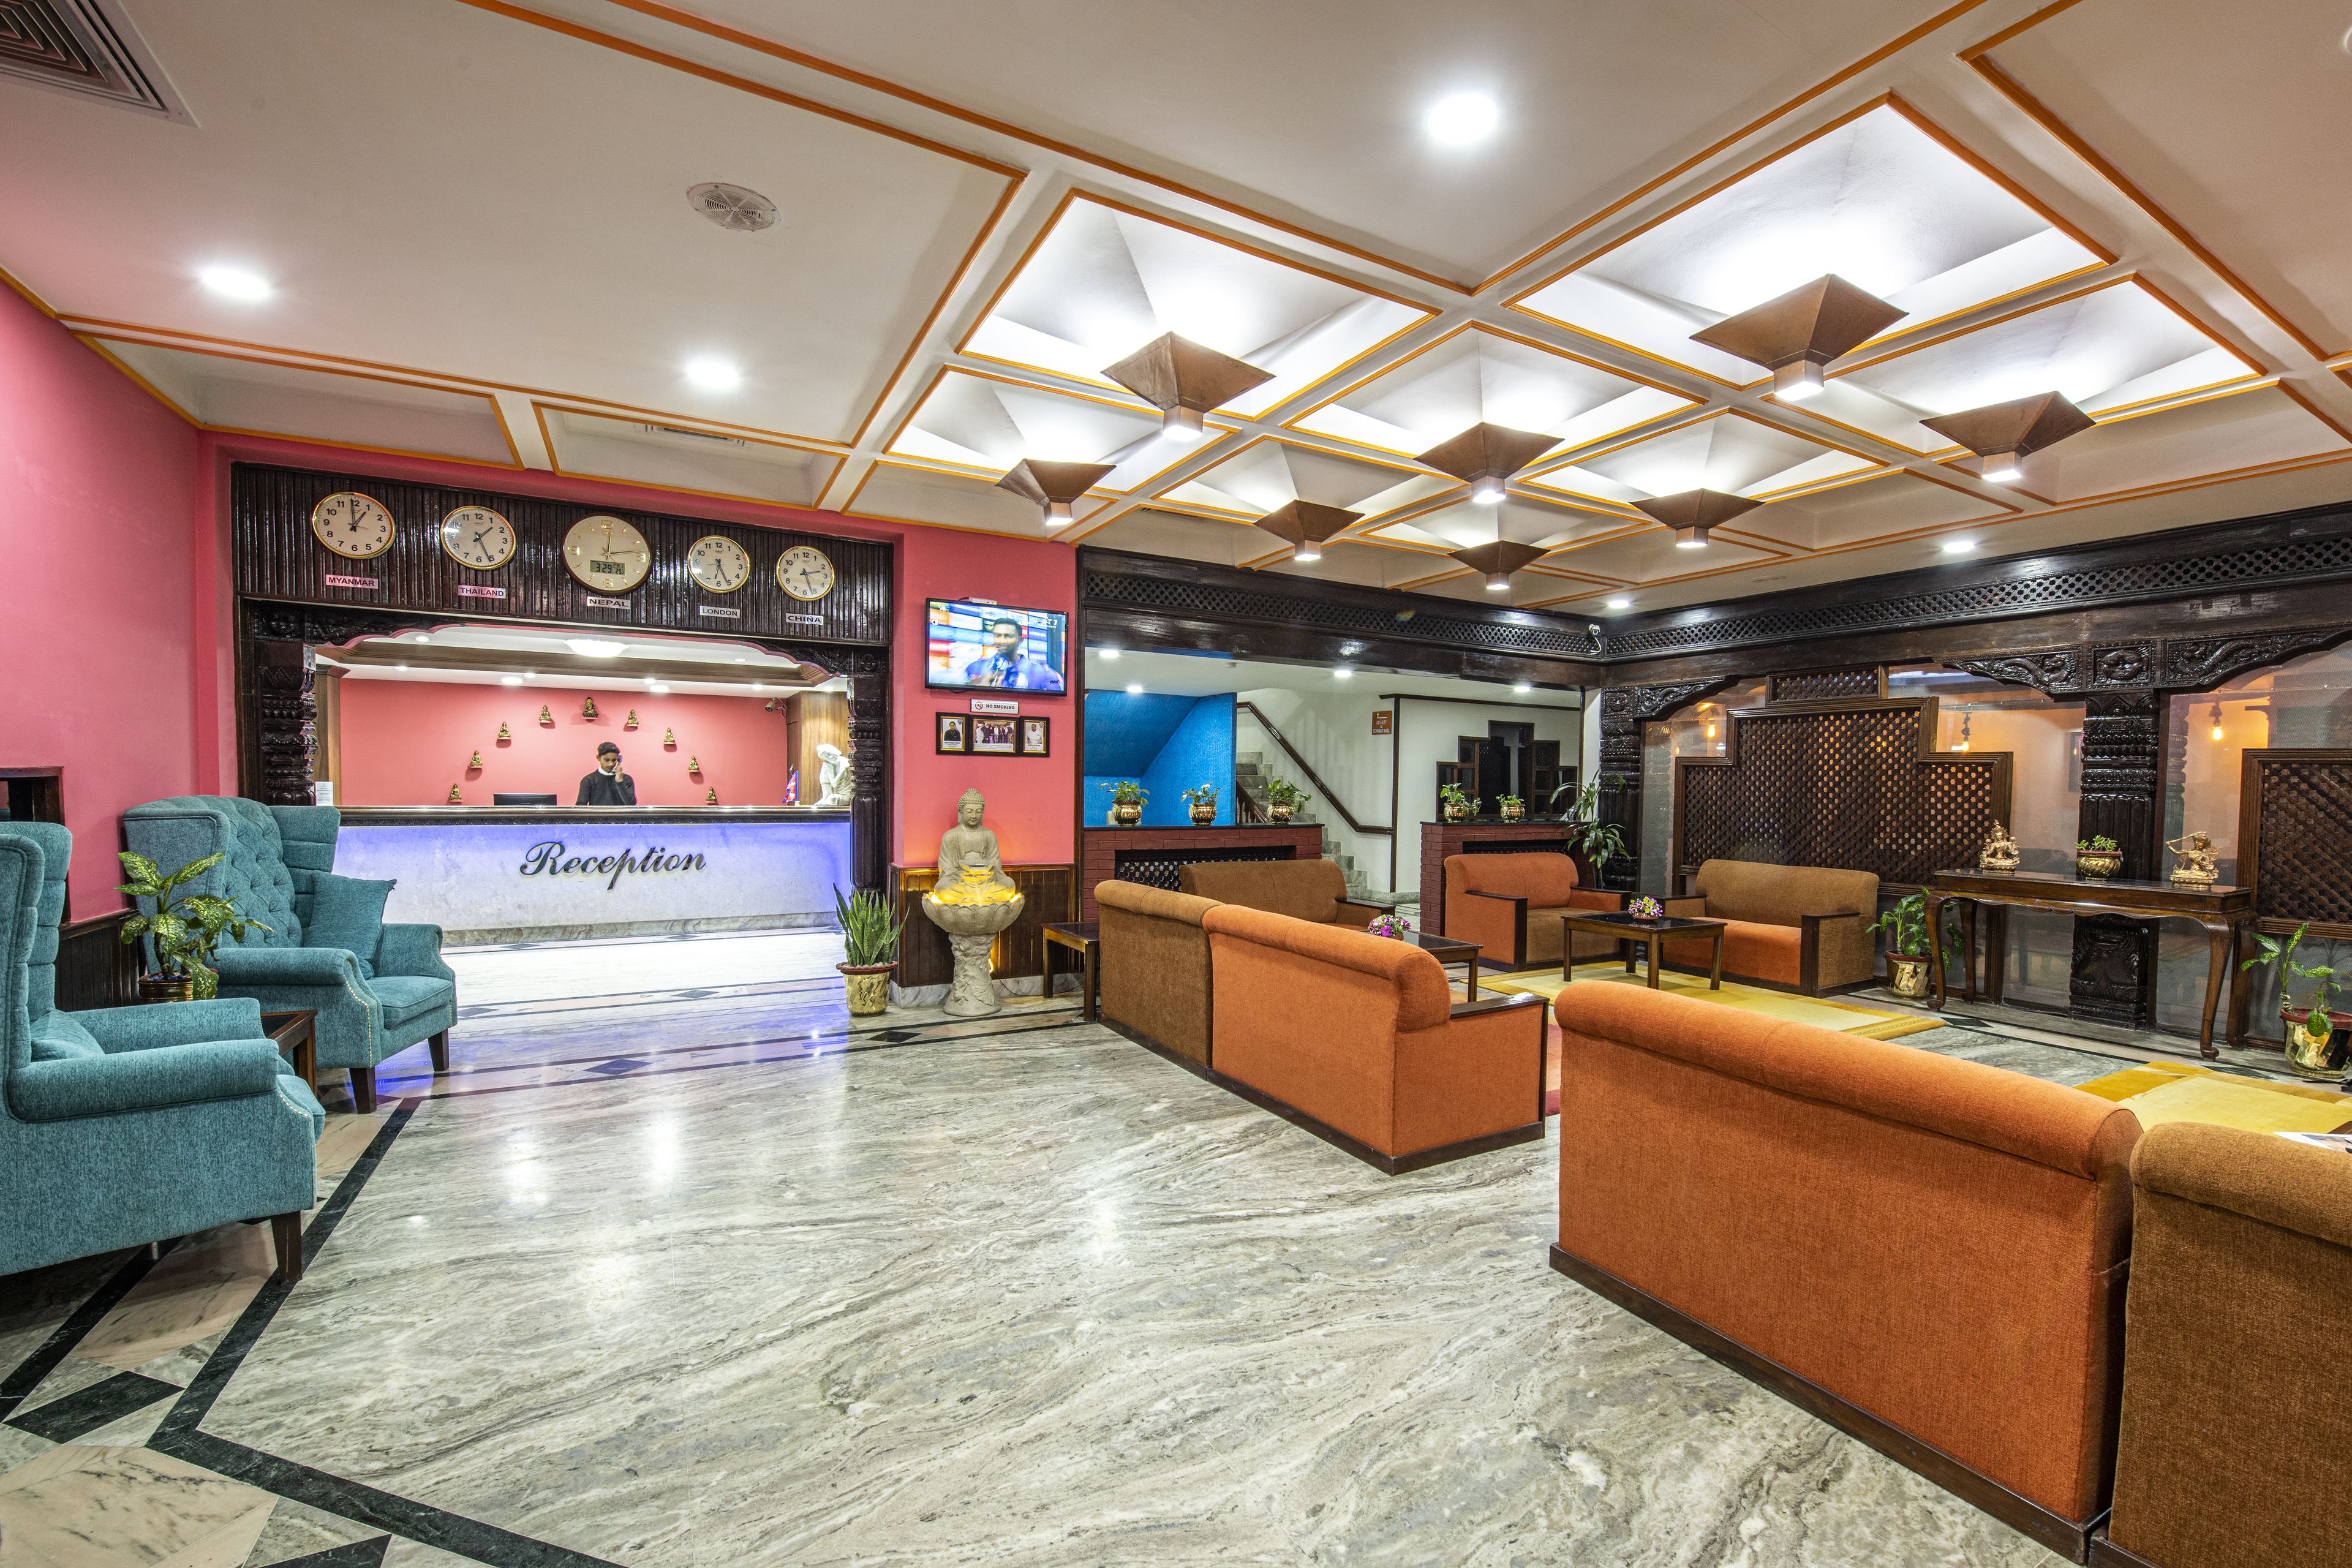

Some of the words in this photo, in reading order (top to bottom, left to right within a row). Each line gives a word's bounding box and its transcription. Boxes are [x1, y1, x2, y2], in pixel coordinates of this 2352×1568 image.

[596, 563, 601, 572] 3
[328, 577, 375, 586] MYANMAR
[461, 588, 503, 597] THAILAND
[589, 598, 628, 607] NEPAL
[702, 608, 737, 616] LONDON
[520, 840, 706, 891] Reception
